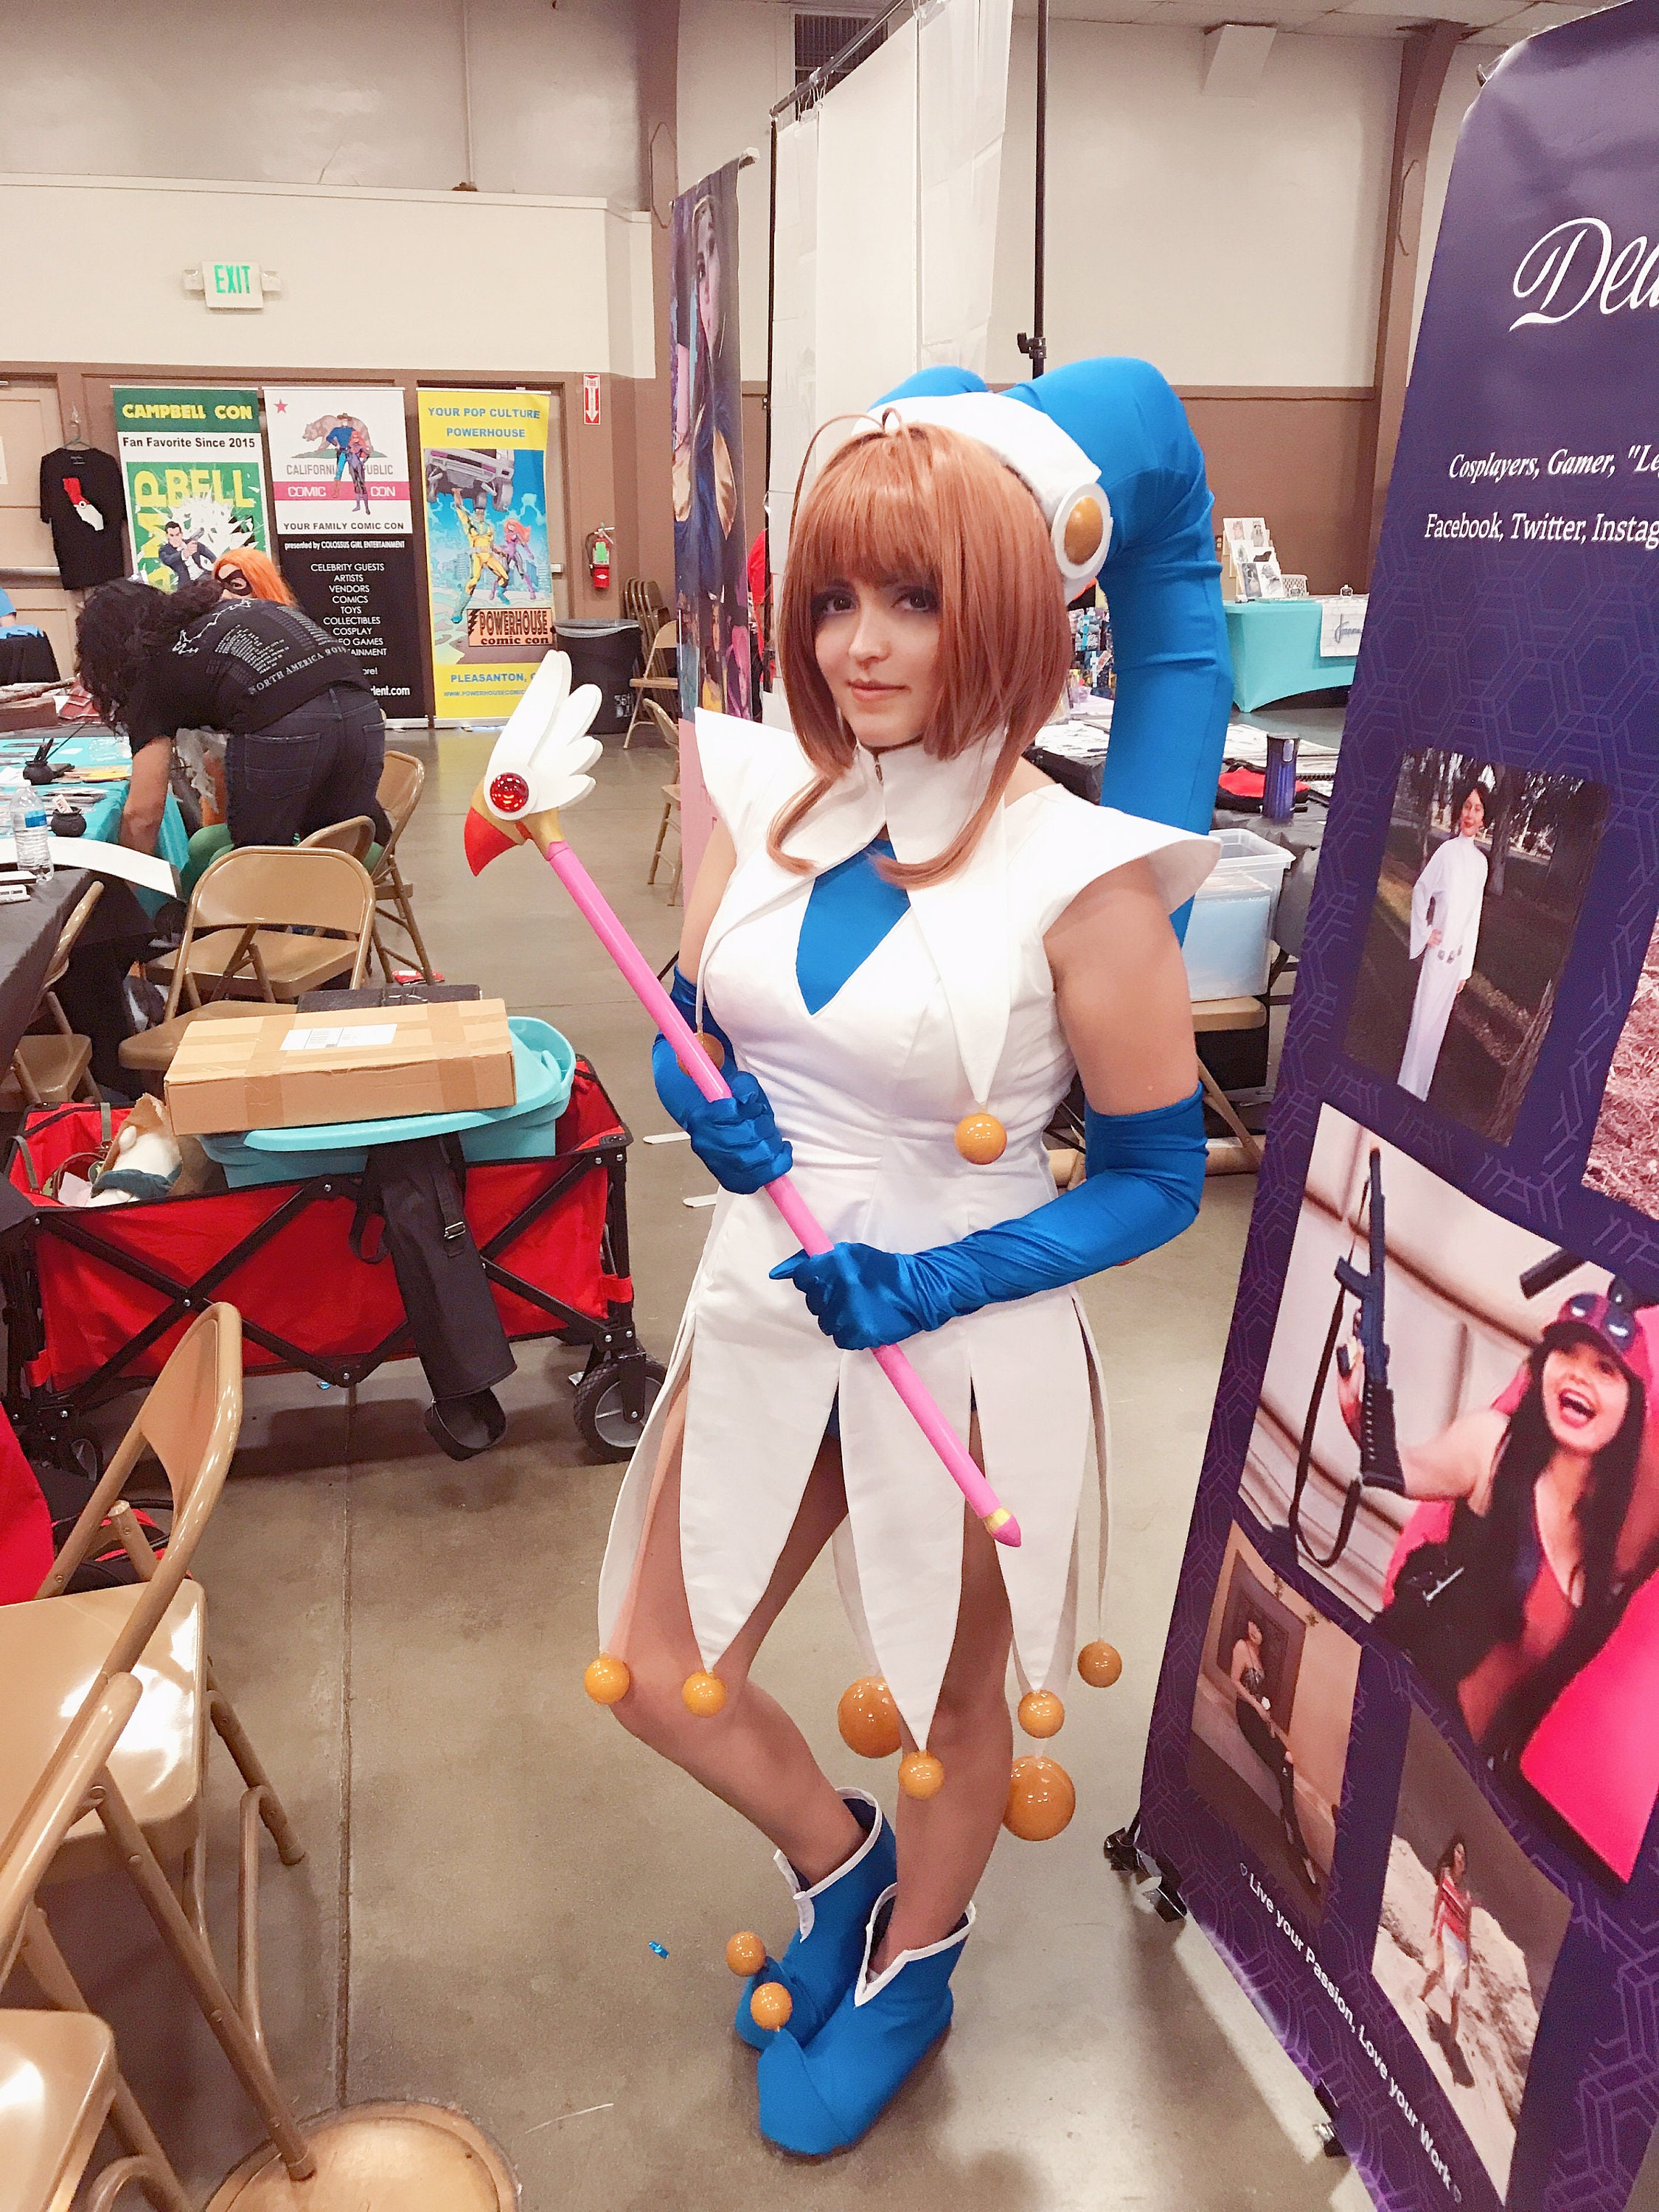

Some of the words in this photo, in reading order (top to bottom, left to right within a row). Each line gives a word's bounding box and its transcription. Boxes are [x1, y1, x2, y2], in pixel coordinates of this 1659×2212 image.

[214, 265, 250, 293] EXIT
[122, 404, 206, 419] CAMPBELL
[215, 405, 253, 420] CON
[428, 407, 460, 417] YOUR
[464, 408, 486, 417] POP
[490, 408, 540, 419] CULTURE
[446, 428, 526, 438] POWERHOUSE
[122, 437, 143, 447] Fan
[147, 437, 192, 447] Favorite
[195, 437, 226, 448] Since
[229, 438, 255, 448] 2015
[1449, 451, 1541, 484] Cosplayers,
[1547, 447, 1616, 479] Gamer,
[1628, 445, 1659, 479] "Le
[286, 465, 335, 475] CALIFORNI
[366, 465, 393, 475] UBLIC
[288, 486, 327, 497] COMIC
[370, 487, 396, 497] CON
[1425, 512, 1504, 543] Facebook,
[1510, 513, 1587, 545] Twitter,
[285, 541, 313, 550] presented
[313, 541, 321, 550] by
[321, 540, 350, 549] COLOSSUS
[351, 540, 363, 549] GIRL
[364, 540, 405, 549] ENTERTAINMENT
[310, 563, 352, 571] CELEBRITY
[354, 563, 385, 571] GUESTS
[333, 574, 364, 582] ARTISTS
[329, 585, 370, 593] VENDORS
[332, 596, 369, 604] COMICS
[340, 606, 362, 614] TOYS
[323, 616, 381, 625] COLLECTIBLES
[479, 611, 548, 636] POWERHOUSE
[333, 627, 372, 636] COSPLAY
[352, 638, 383, 646] GAMES
[481, 636, 521, 645] comic
[350, 648, 387, 656] AINMENT
[285, 653, 324, 675] AMERICA
[451, 673, 527, 683] PLEASANTON,
[1250, 1873, 1274, 1913] Live
[1276, 1910, 1304, 1952] your
[1306, 1947, 1355, 2034] Passion,
[1359, 2025, 1388, 2080] Love
[1388, 2077, 1418, 2127] your
[1420, 2123, 1451, 2192] Work
